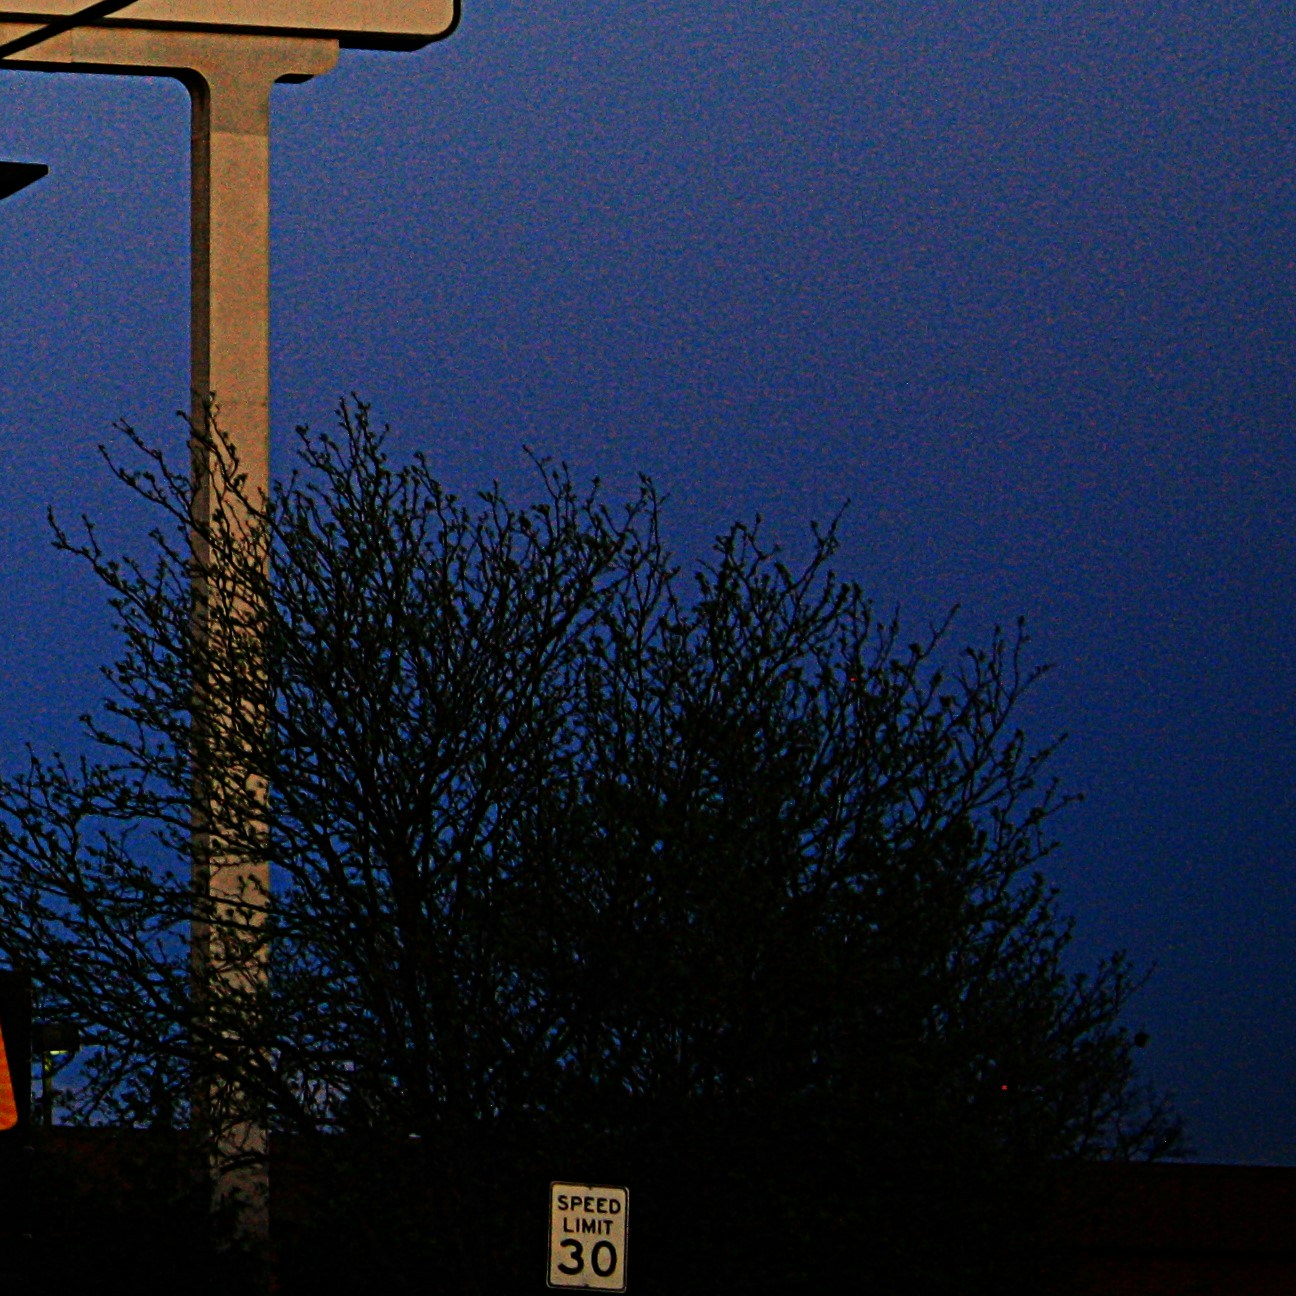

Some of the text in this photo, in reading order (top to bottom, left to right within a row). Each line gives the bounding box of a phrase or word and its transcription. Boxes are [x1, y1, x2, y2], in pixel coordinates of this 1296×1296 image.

[557, 1194, 621, 1215] SPEED
[563, 1216, 613, 1235] LIMIT
[557, 1238, 618, 1277] 30
